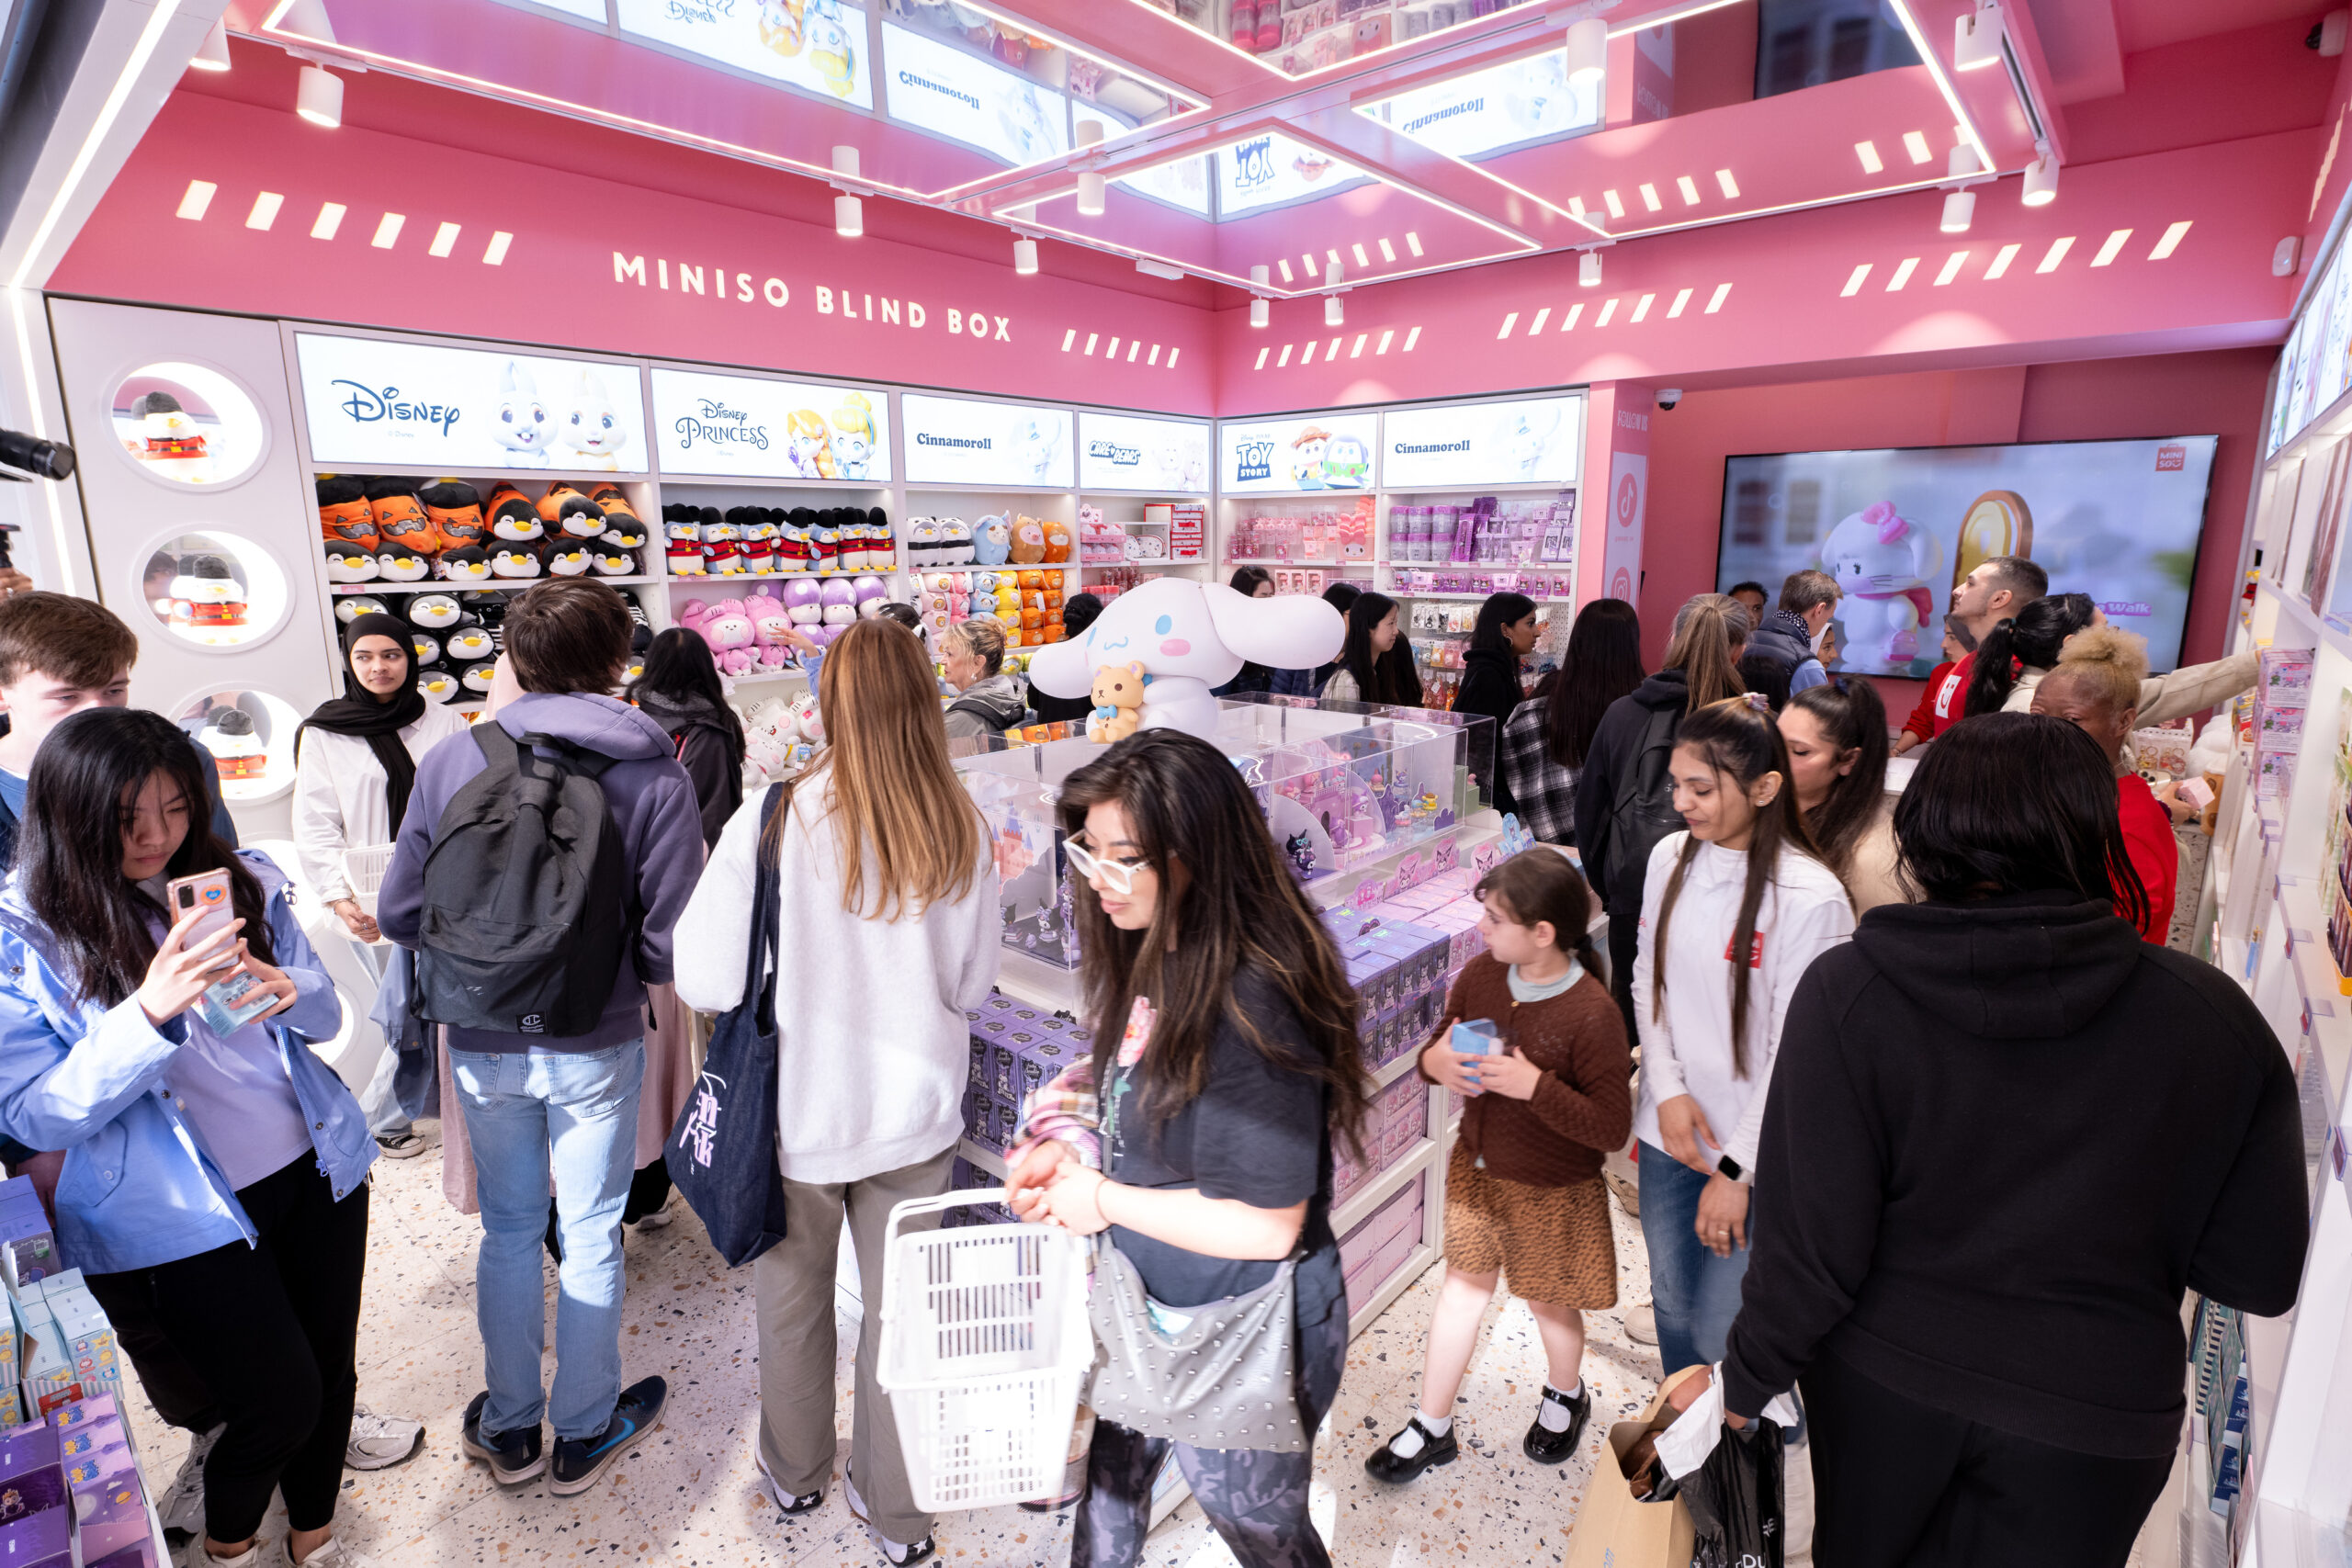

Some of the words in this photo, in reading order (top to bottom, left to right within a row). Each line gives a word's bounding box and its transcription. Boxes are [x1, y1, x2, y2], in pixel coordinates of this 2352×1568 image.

[613, 251, 790, 308] MINISO
[816, 286, 926, 328] BLIND
[947, 308, 1012, 342] BOX
[917, 433, 991, 449] Cinnamoroll
[1088, 440, 1114, 458] CARE
[1395, 440, 1470, 454] Cinnamoroll
[1237, 442, 1274, 468] TOY
[1240, 468, 1268, 478] STORY
[2108, 602, 2151, 614] Walk
